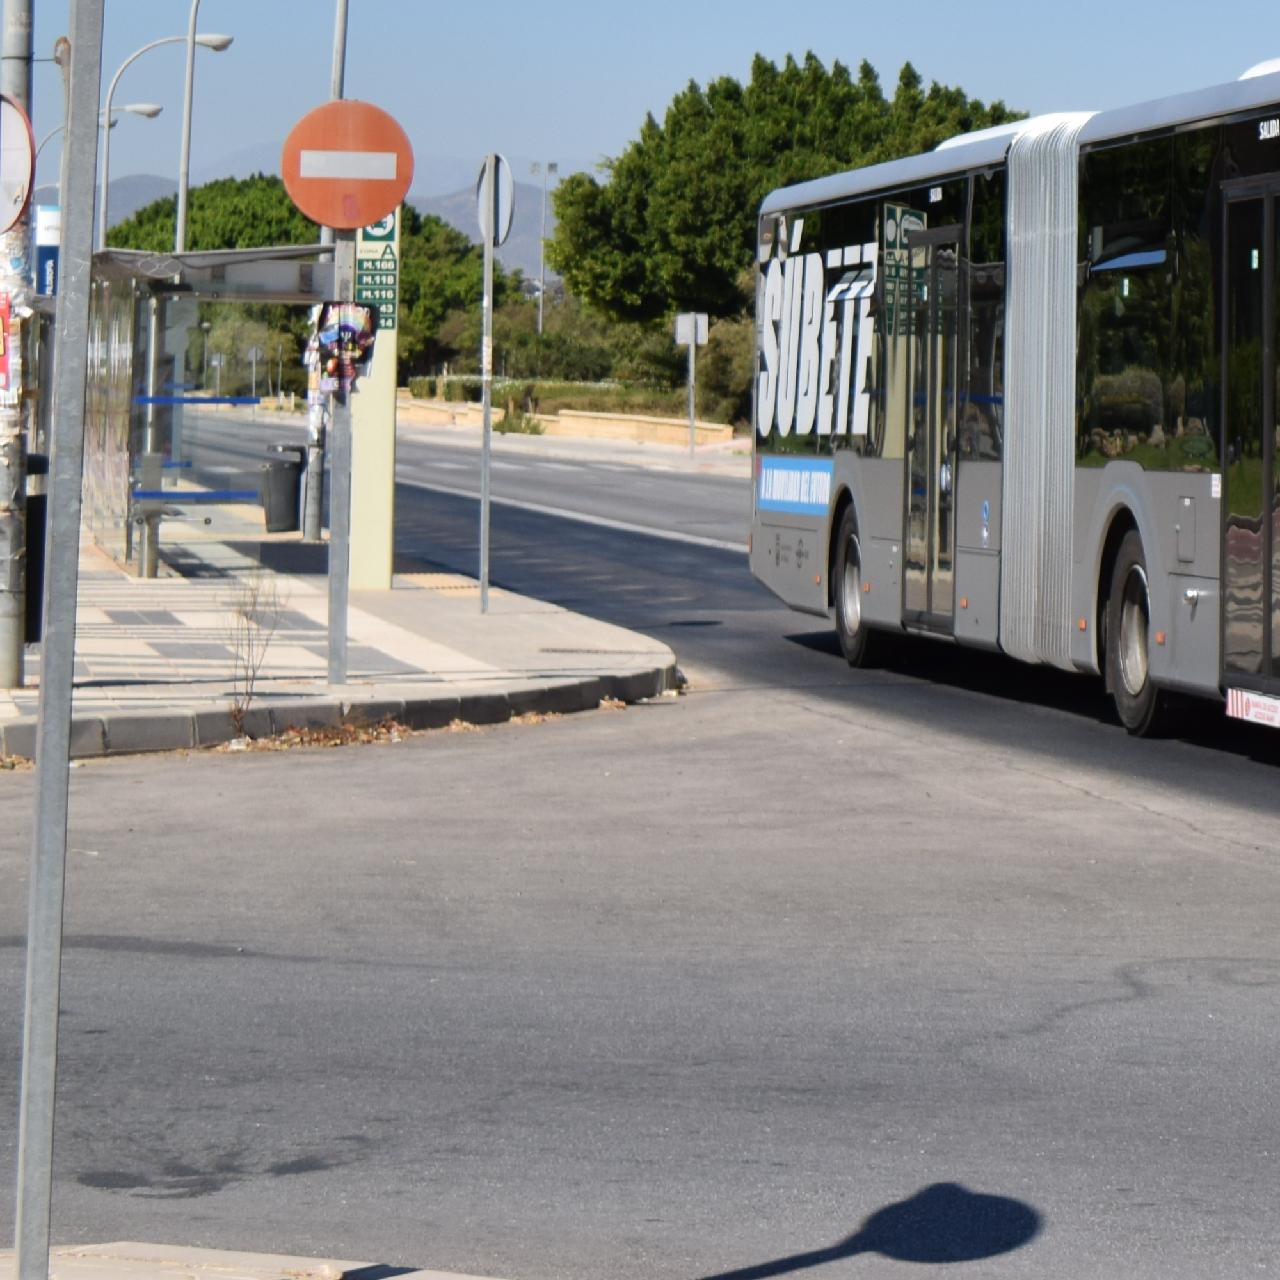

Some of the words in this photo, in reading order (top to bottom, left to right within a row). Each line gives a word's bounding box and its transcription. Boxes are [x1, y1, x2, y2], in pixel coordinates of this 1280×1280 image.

[1260, 119, 1280, 140] SALIDA
[380, 243, 396, 260] A
[758, 219, 879, 437] SÚBETE
